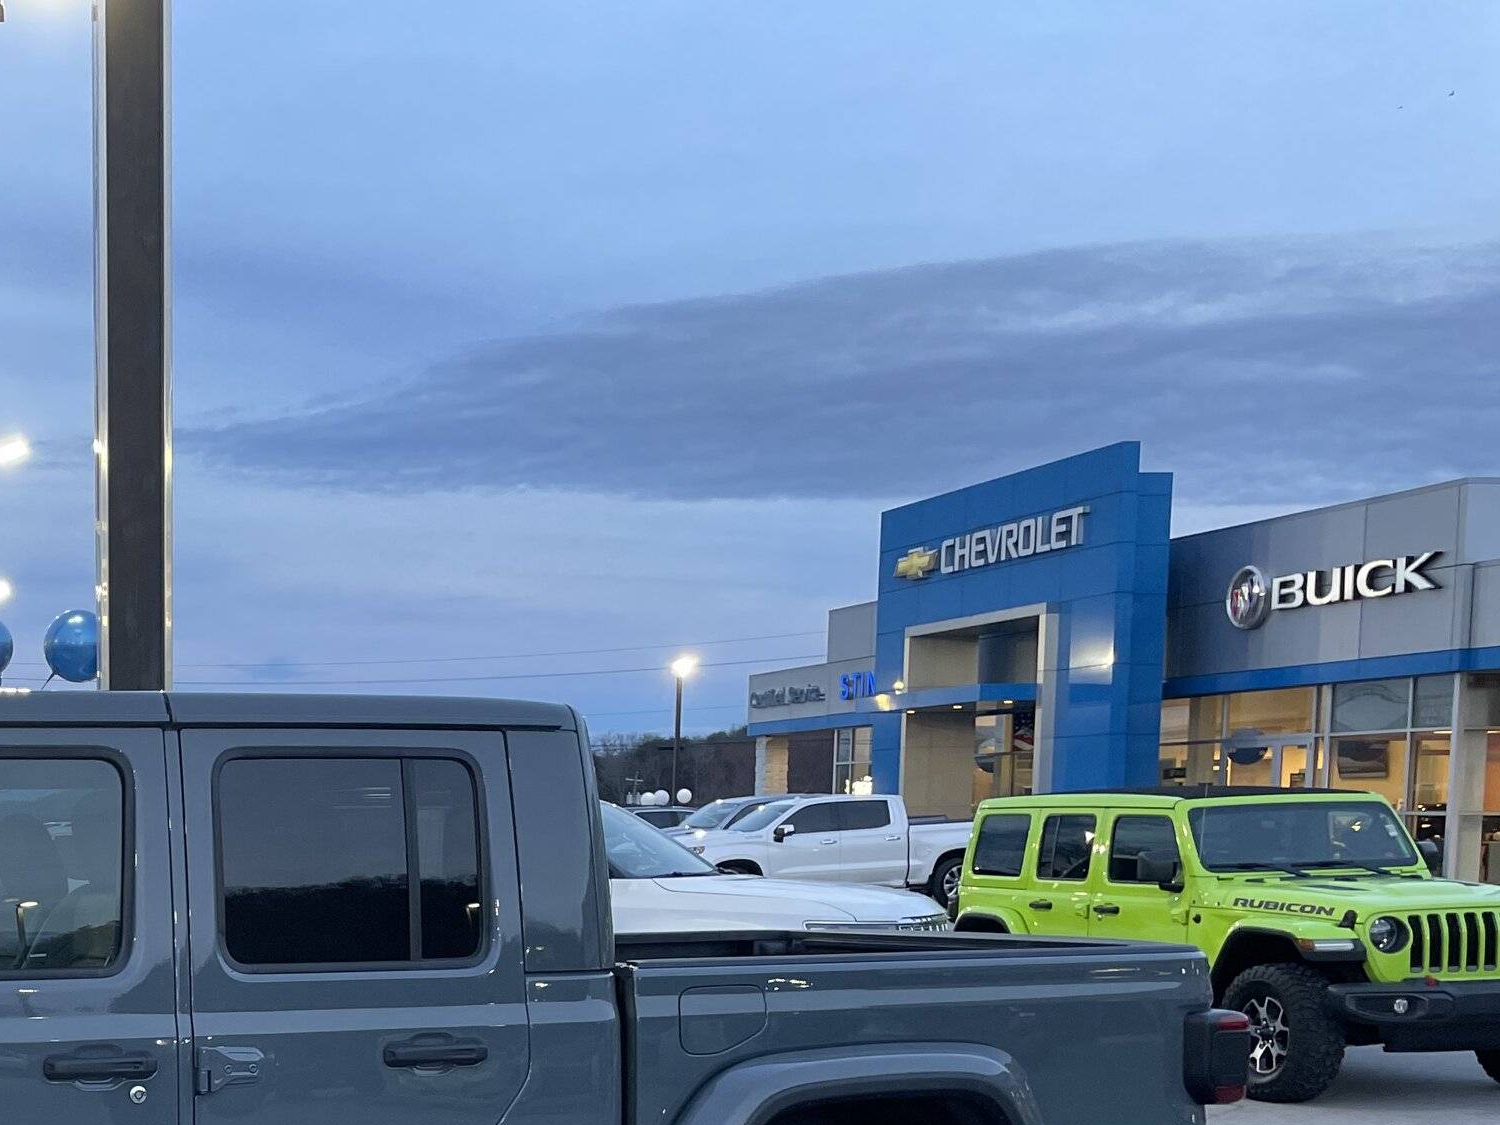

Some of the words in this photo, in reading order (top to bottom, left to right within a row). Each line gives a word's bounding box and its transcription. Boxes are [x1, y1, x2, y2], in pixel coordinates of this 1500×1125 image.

[940, 506, 1086, 574] CHEVROLET
[1271, 551, 1441, 610] BUICK
[1233, 898, 1335, 916] RUBICON
